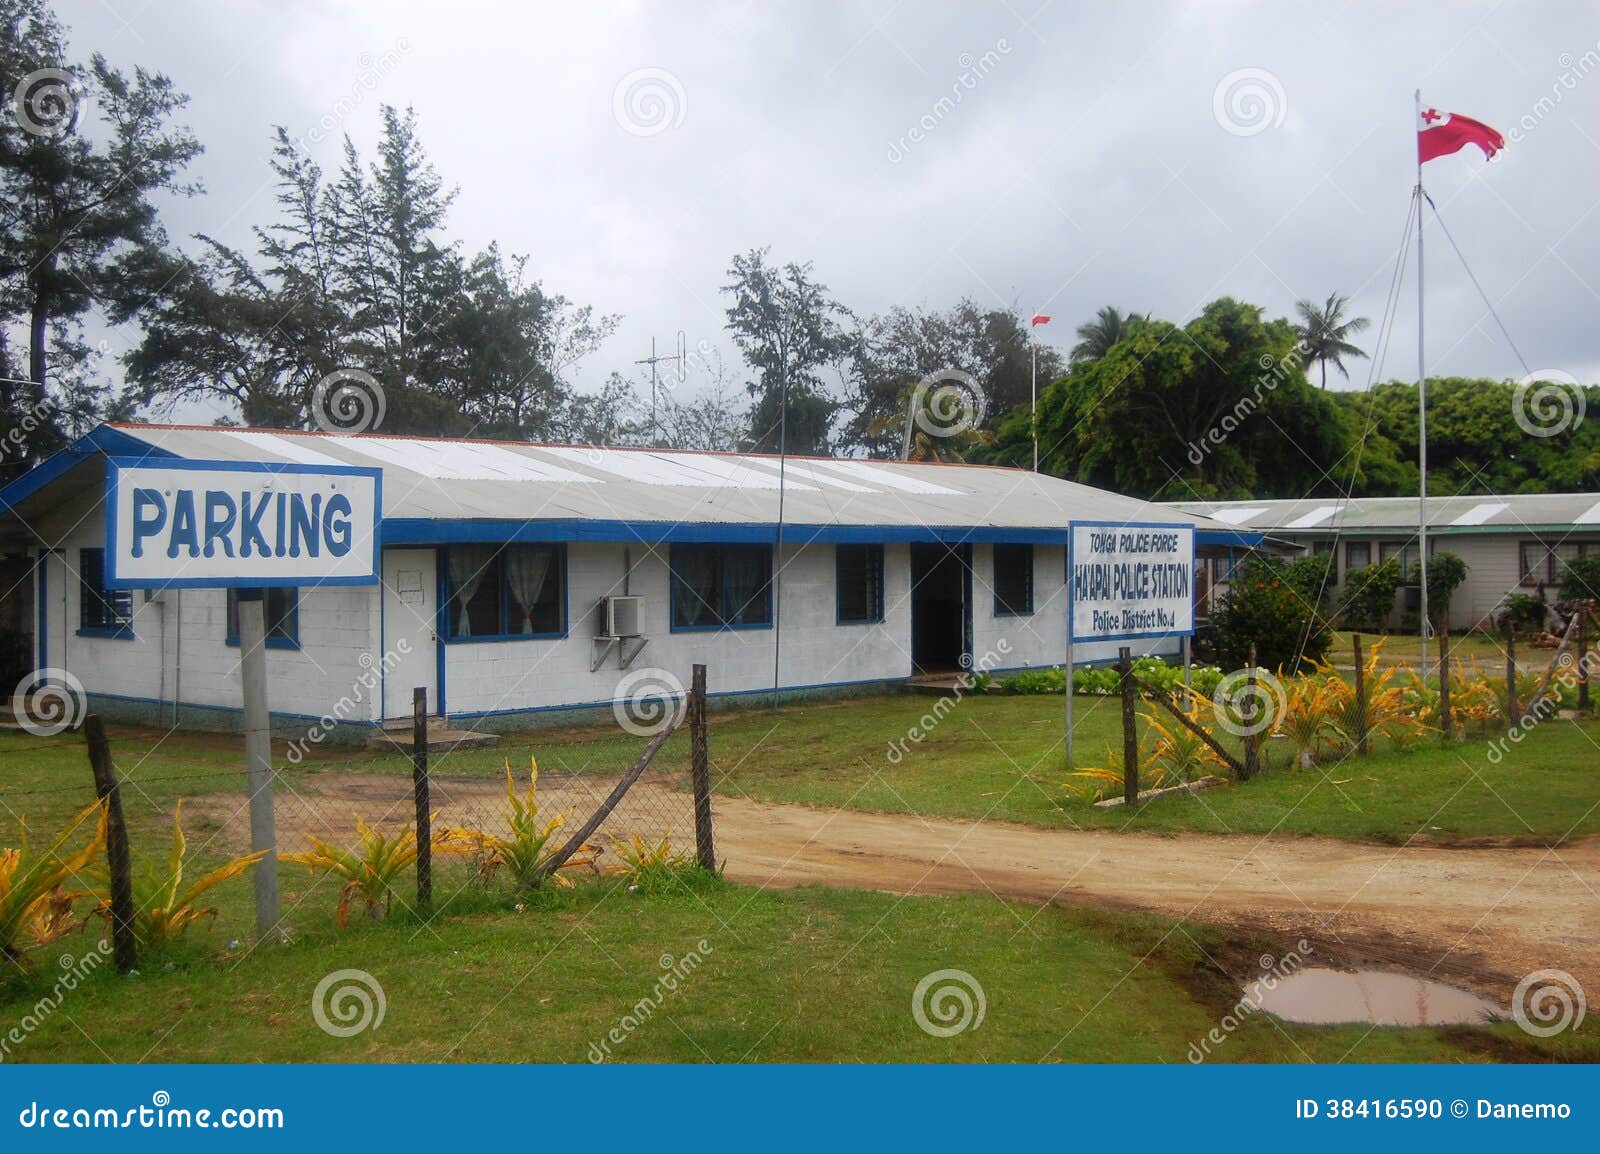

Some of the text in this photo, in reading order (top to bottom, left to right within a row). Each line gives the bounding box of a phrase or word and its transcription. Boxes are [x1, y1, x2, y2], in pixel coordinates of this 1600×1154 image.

[131, 487, 352, 558] PARKING
[1090, 533, 1179, 553] TONGA POLICE FORCE
[1113, 562, 1149, 601] POLICE
[1151, 562, 1188, 599] STATION
[1093, 609, 1120, 631] Police
[1122, 609, 1155, 630] District
